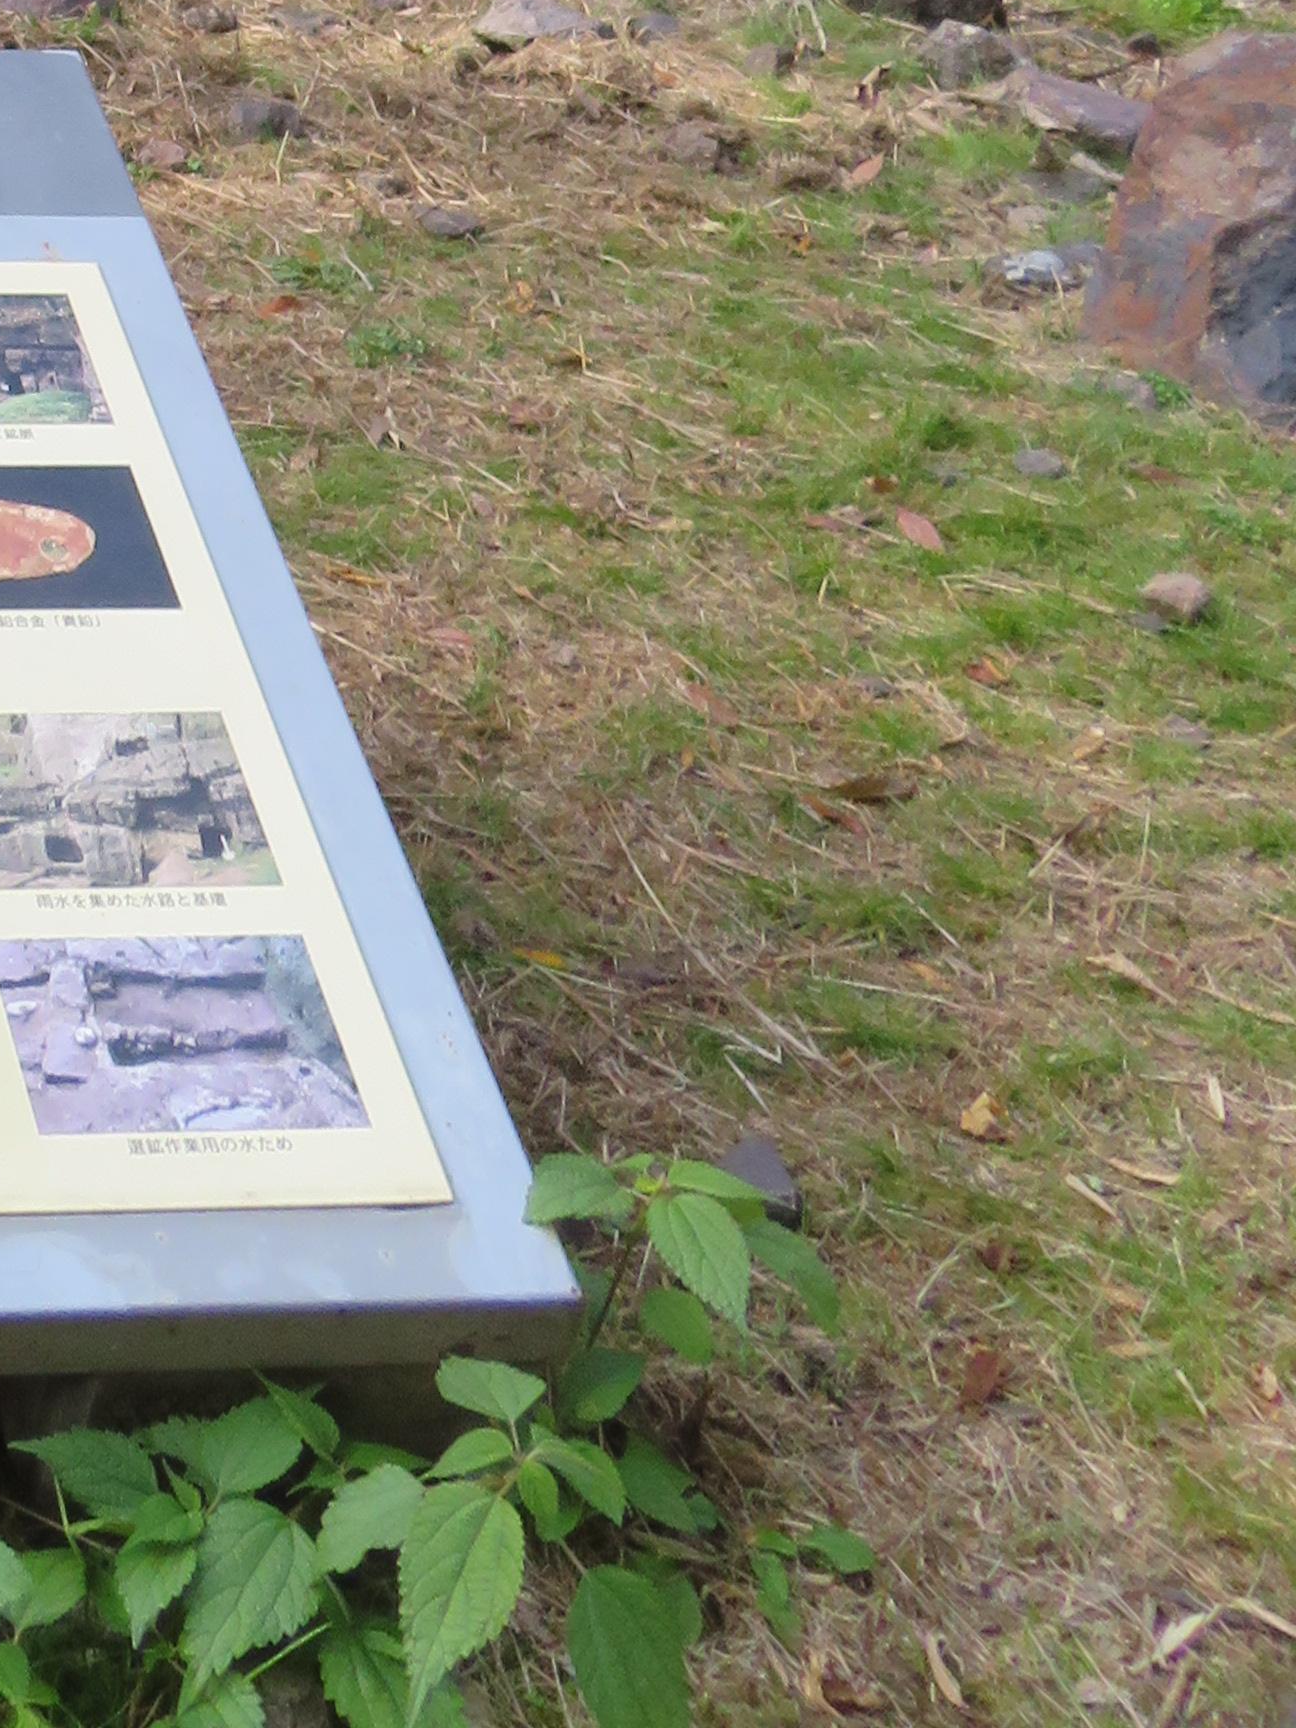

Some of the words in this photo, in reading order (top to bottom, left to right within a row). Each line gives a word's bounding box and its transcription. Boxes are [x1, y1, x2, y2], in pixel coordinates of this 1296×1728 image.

[128, 1136, 293, 1155] 選鉱作業用の水ため
